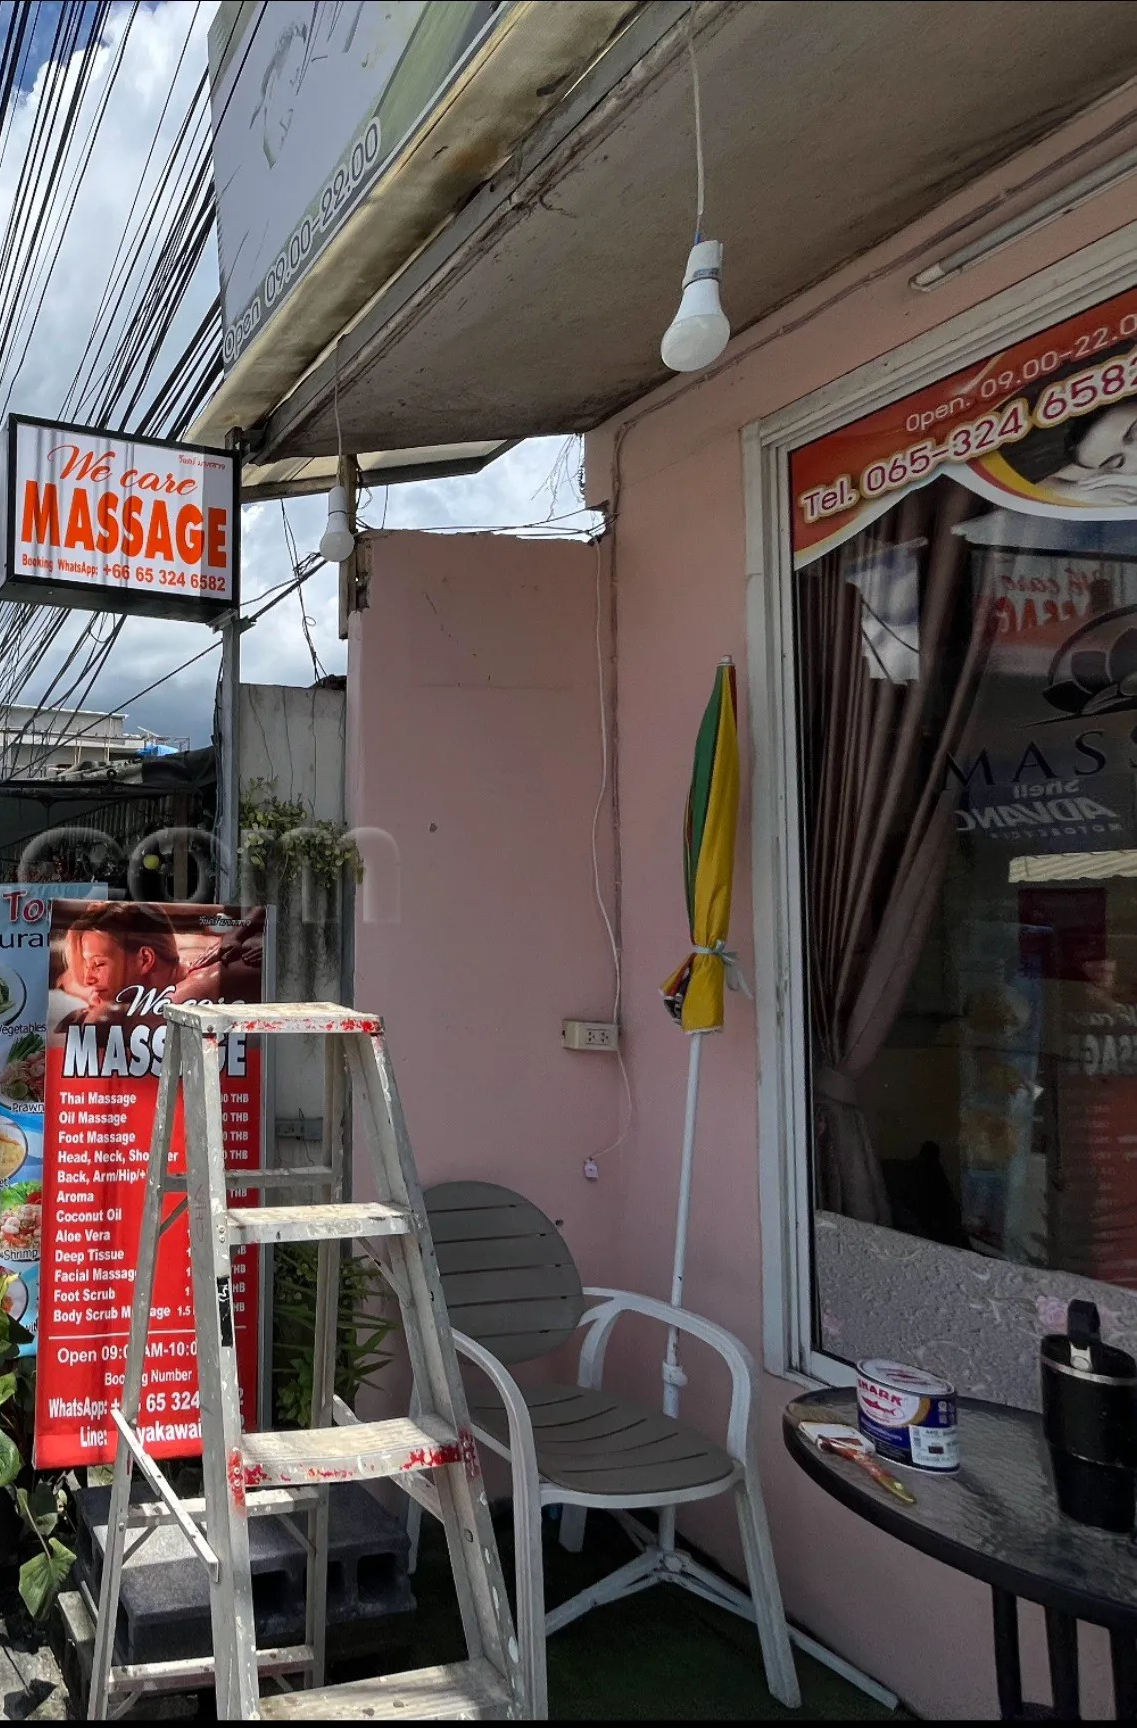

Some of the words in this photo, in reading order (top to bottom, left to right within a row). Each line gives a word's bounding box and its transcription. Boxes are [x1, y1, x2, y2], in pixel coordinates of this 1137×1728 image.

[224, 297, 261, 364] Open
[47, 445, 116, 482] We
[120, 468, 197, 495] care
[802, 475, 857, 519] Tel.
[865, 405, 1026, 494] 065-324
[21, 480, 227, 568] MASSAGE
[22, 553, 53, 572] Booking
[58, 558, 99, 578] WhatsApp:
[103, 564, 130, 580] +66
[135, 567, 154, 583] 65
[159, 569, 186, 588] 324
[190, 573, 226, 592] 6582
[942, 725, 1137, 790] MAS
[2, 890, 51, 924] To
[63, 1024, 247, 1077] MASSE
[13, 1102, 45, 1113] Prawn
[60, 1091, 85, 1105] Thai
[88, 1091, 137, 1107] Massage
[230, 1093, 249, 1103] THB
[59, 1111, 75, 1124] Oil
[78, 1111, 127, 1126] Massage
[230, 1112, 249, 1122] THB
[58, 1131, 84, 1143] Foot
[87, 1130, 136, 1145] Massage
[230, 1130, 248, 1141] THB
[58, 1150, 91, 1165] Head,
[94, 1150, 125, 1164] Neck,
[128, 1149, 179, 1162] Shoer
[229, 1149, 248, 1160] THB
[57, 1170, 90, 1185] Back,
[93, 1168, 148, 1184] Arm/Hip/+
[56, 1190, 94, 1203] Aroma
[229, 1188, 248, 1198] THB
[56, 1208, 104, 1222] Coconut
[107, 1207, 122, 1221] Oil
[55, 1229, 82, 1242] Aloe
[85, 1228, 111, 1242] Vera
[3, 1249, 38, 1261] Shrimp
[55, 1249, 85, 1265] Deep
[87, 1248, 125, 1261] Tissue
[54, 1269, 90, 1282] Facial
[92, 1267, 137, 1282] Massag
[231, 1264, 246, 1275] HB
[54, 1289, 80, 1302] Foot
[83, 1287, 116, 1301] Scrub
[232, 1282, 246, 1293] HB
[53, 1309, 83, 1325] Body
[85, 1306, 118, 1321] Scrub
[121, 1305, 171, 1320] Mage
[177, 1305, 191, 1316] 1.5
[233, 1301, 245, 1312] HB
[57, 1347, 97, 1366] Open
[101, 1345, 128, 1361] 09:0
[145, 1341, 198, 1358] AM-10:0
[104, 1372, 148, 1387] Boog
[151, 1368, 193, 1383] Number
[49, 1396, 108, 1421] WhatsApp:
[146, 1392, 166, 1412] 65
[171, 1390, 200, 1411] 324
[80, 1425, 108, 1448] Line:
